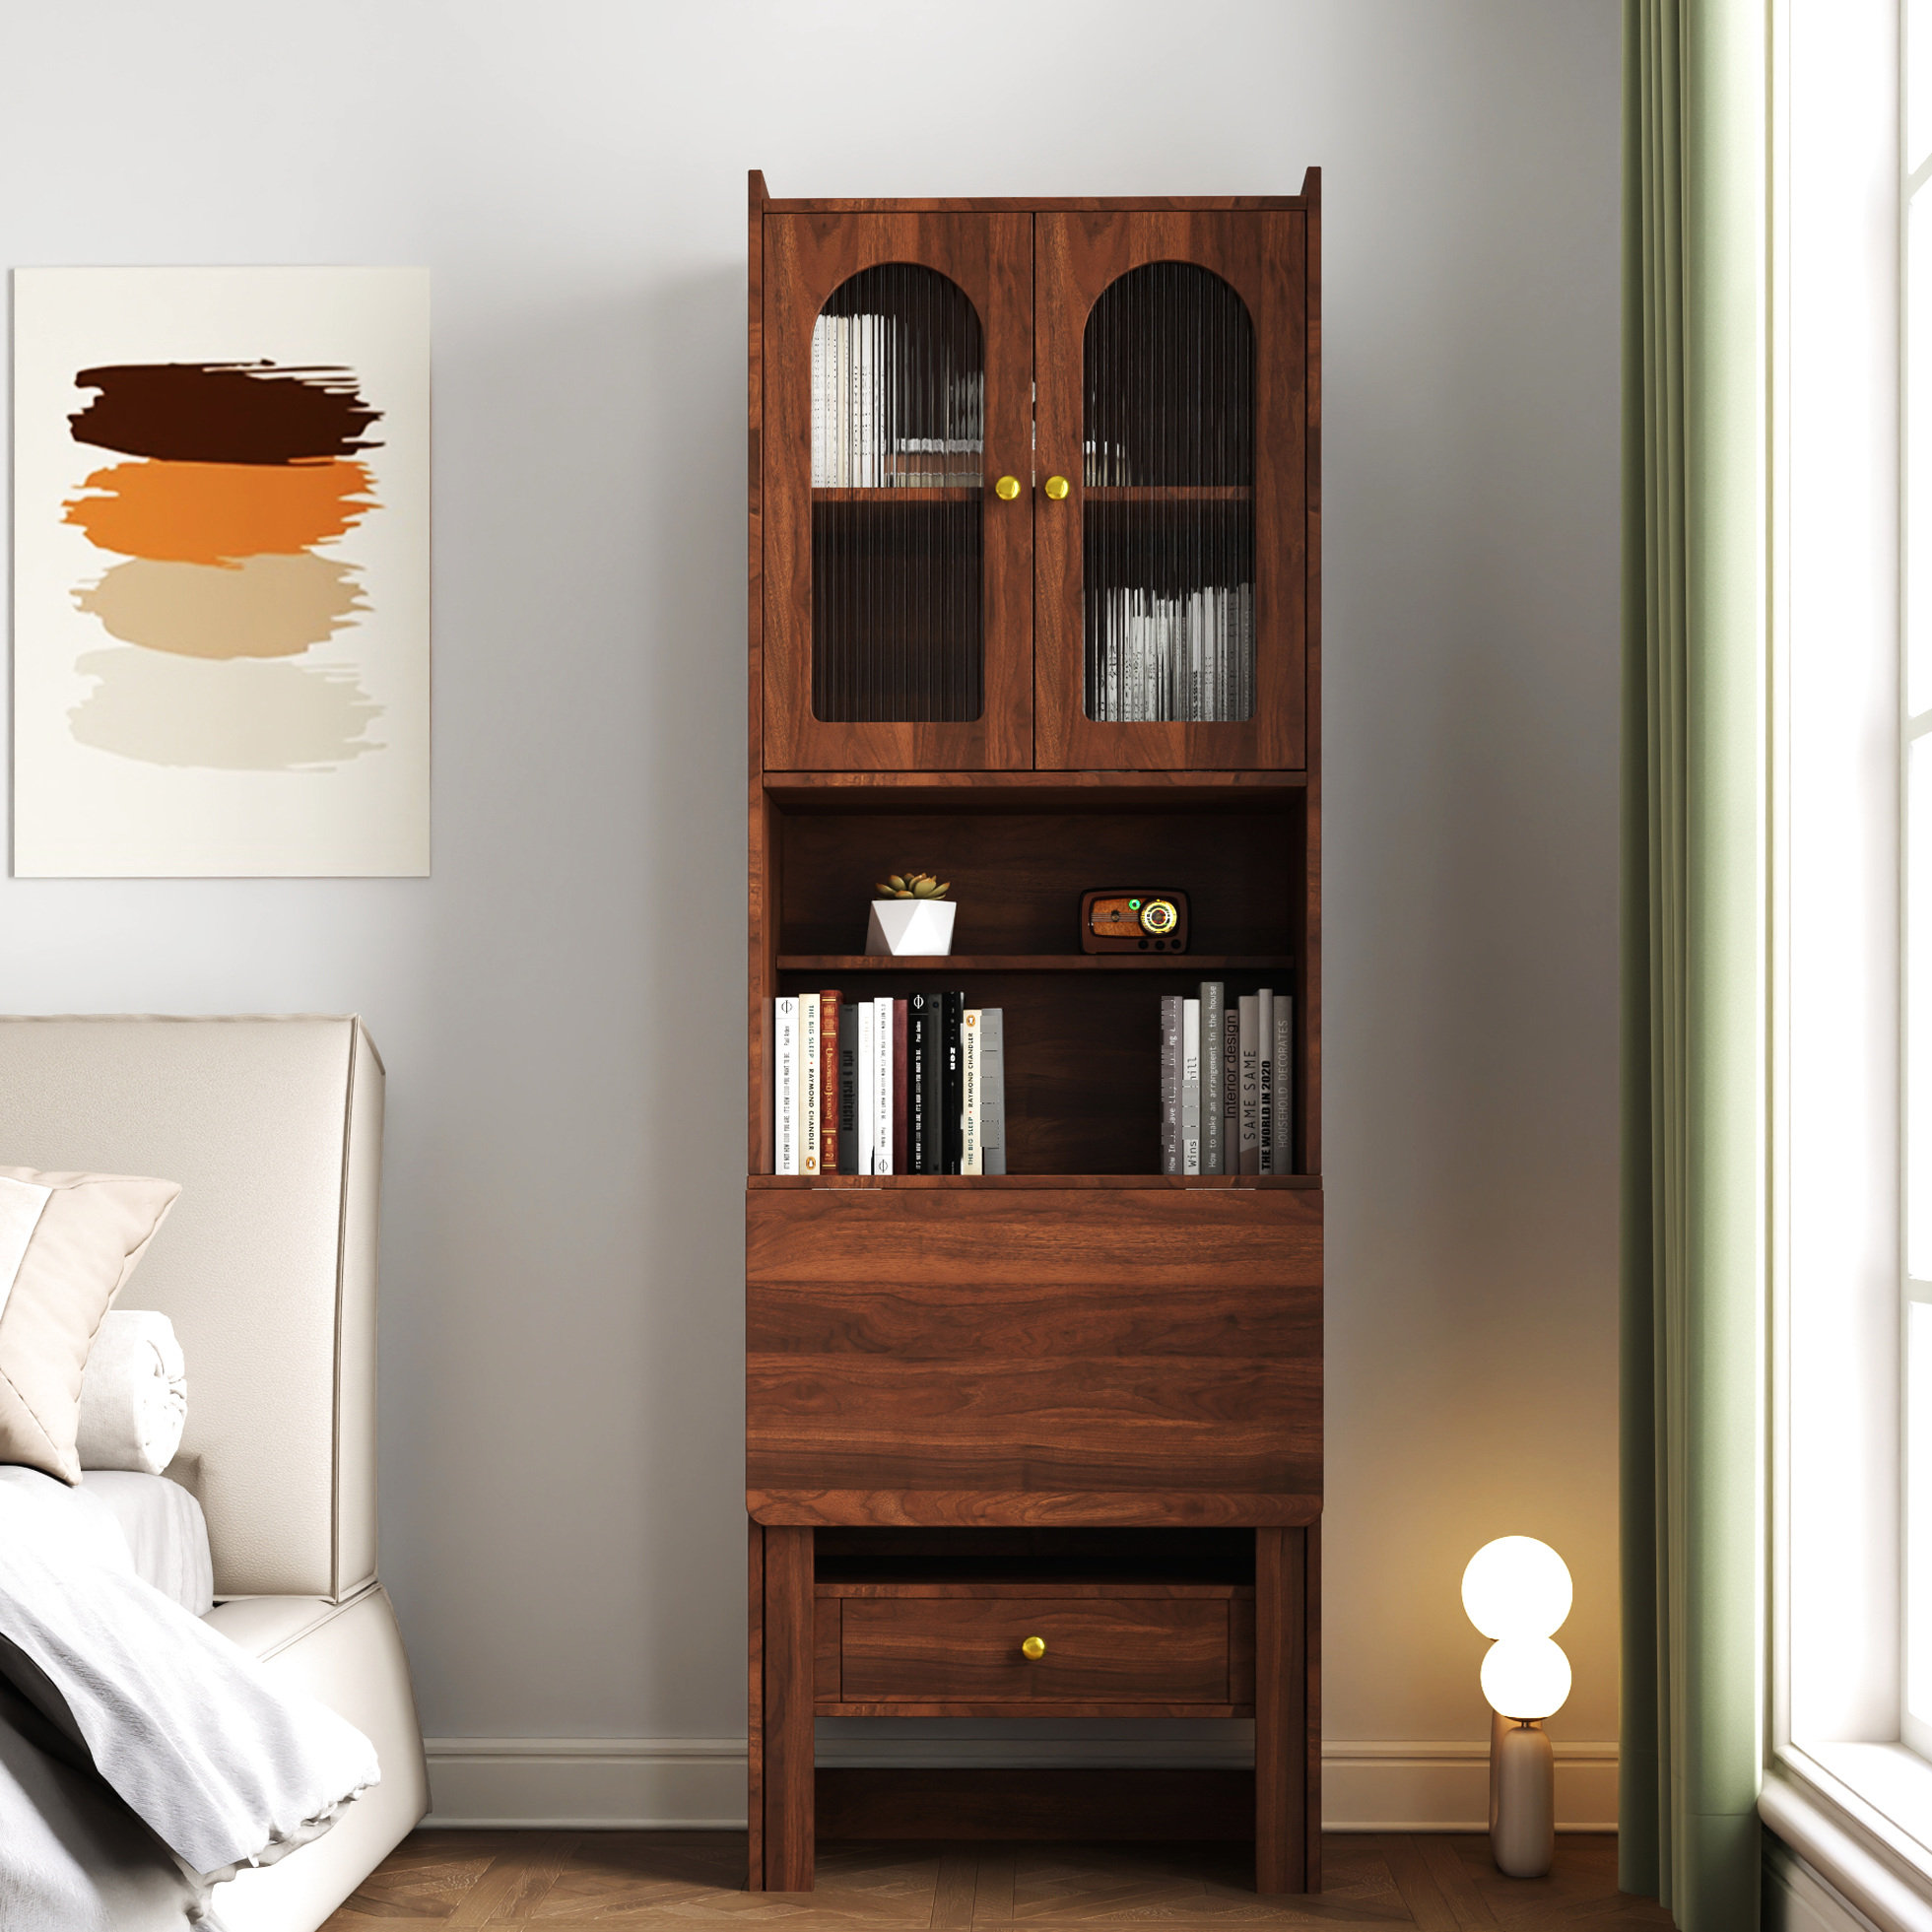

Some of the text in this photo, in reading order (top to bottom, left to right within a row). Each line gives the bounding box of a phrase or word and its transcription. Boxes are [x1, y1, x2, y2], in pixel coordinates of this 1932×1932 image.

[1209, 1032, 1216, 1042] in
[1225, 1015, 1238, 1119] Interior design
[1209, 1047, 1218, 1098] arrangement
[1211, 1102, 1216, 1112] an
[1244, 1050, 1256, 1140] SAME SAME
[1277, 1020, 1288, 1148] HOUSEHOLD DECORATES
[1209, 1139, 1216, 1149] to
[1261, 1061, 1271, 1170] THE WORLD IN 2020
